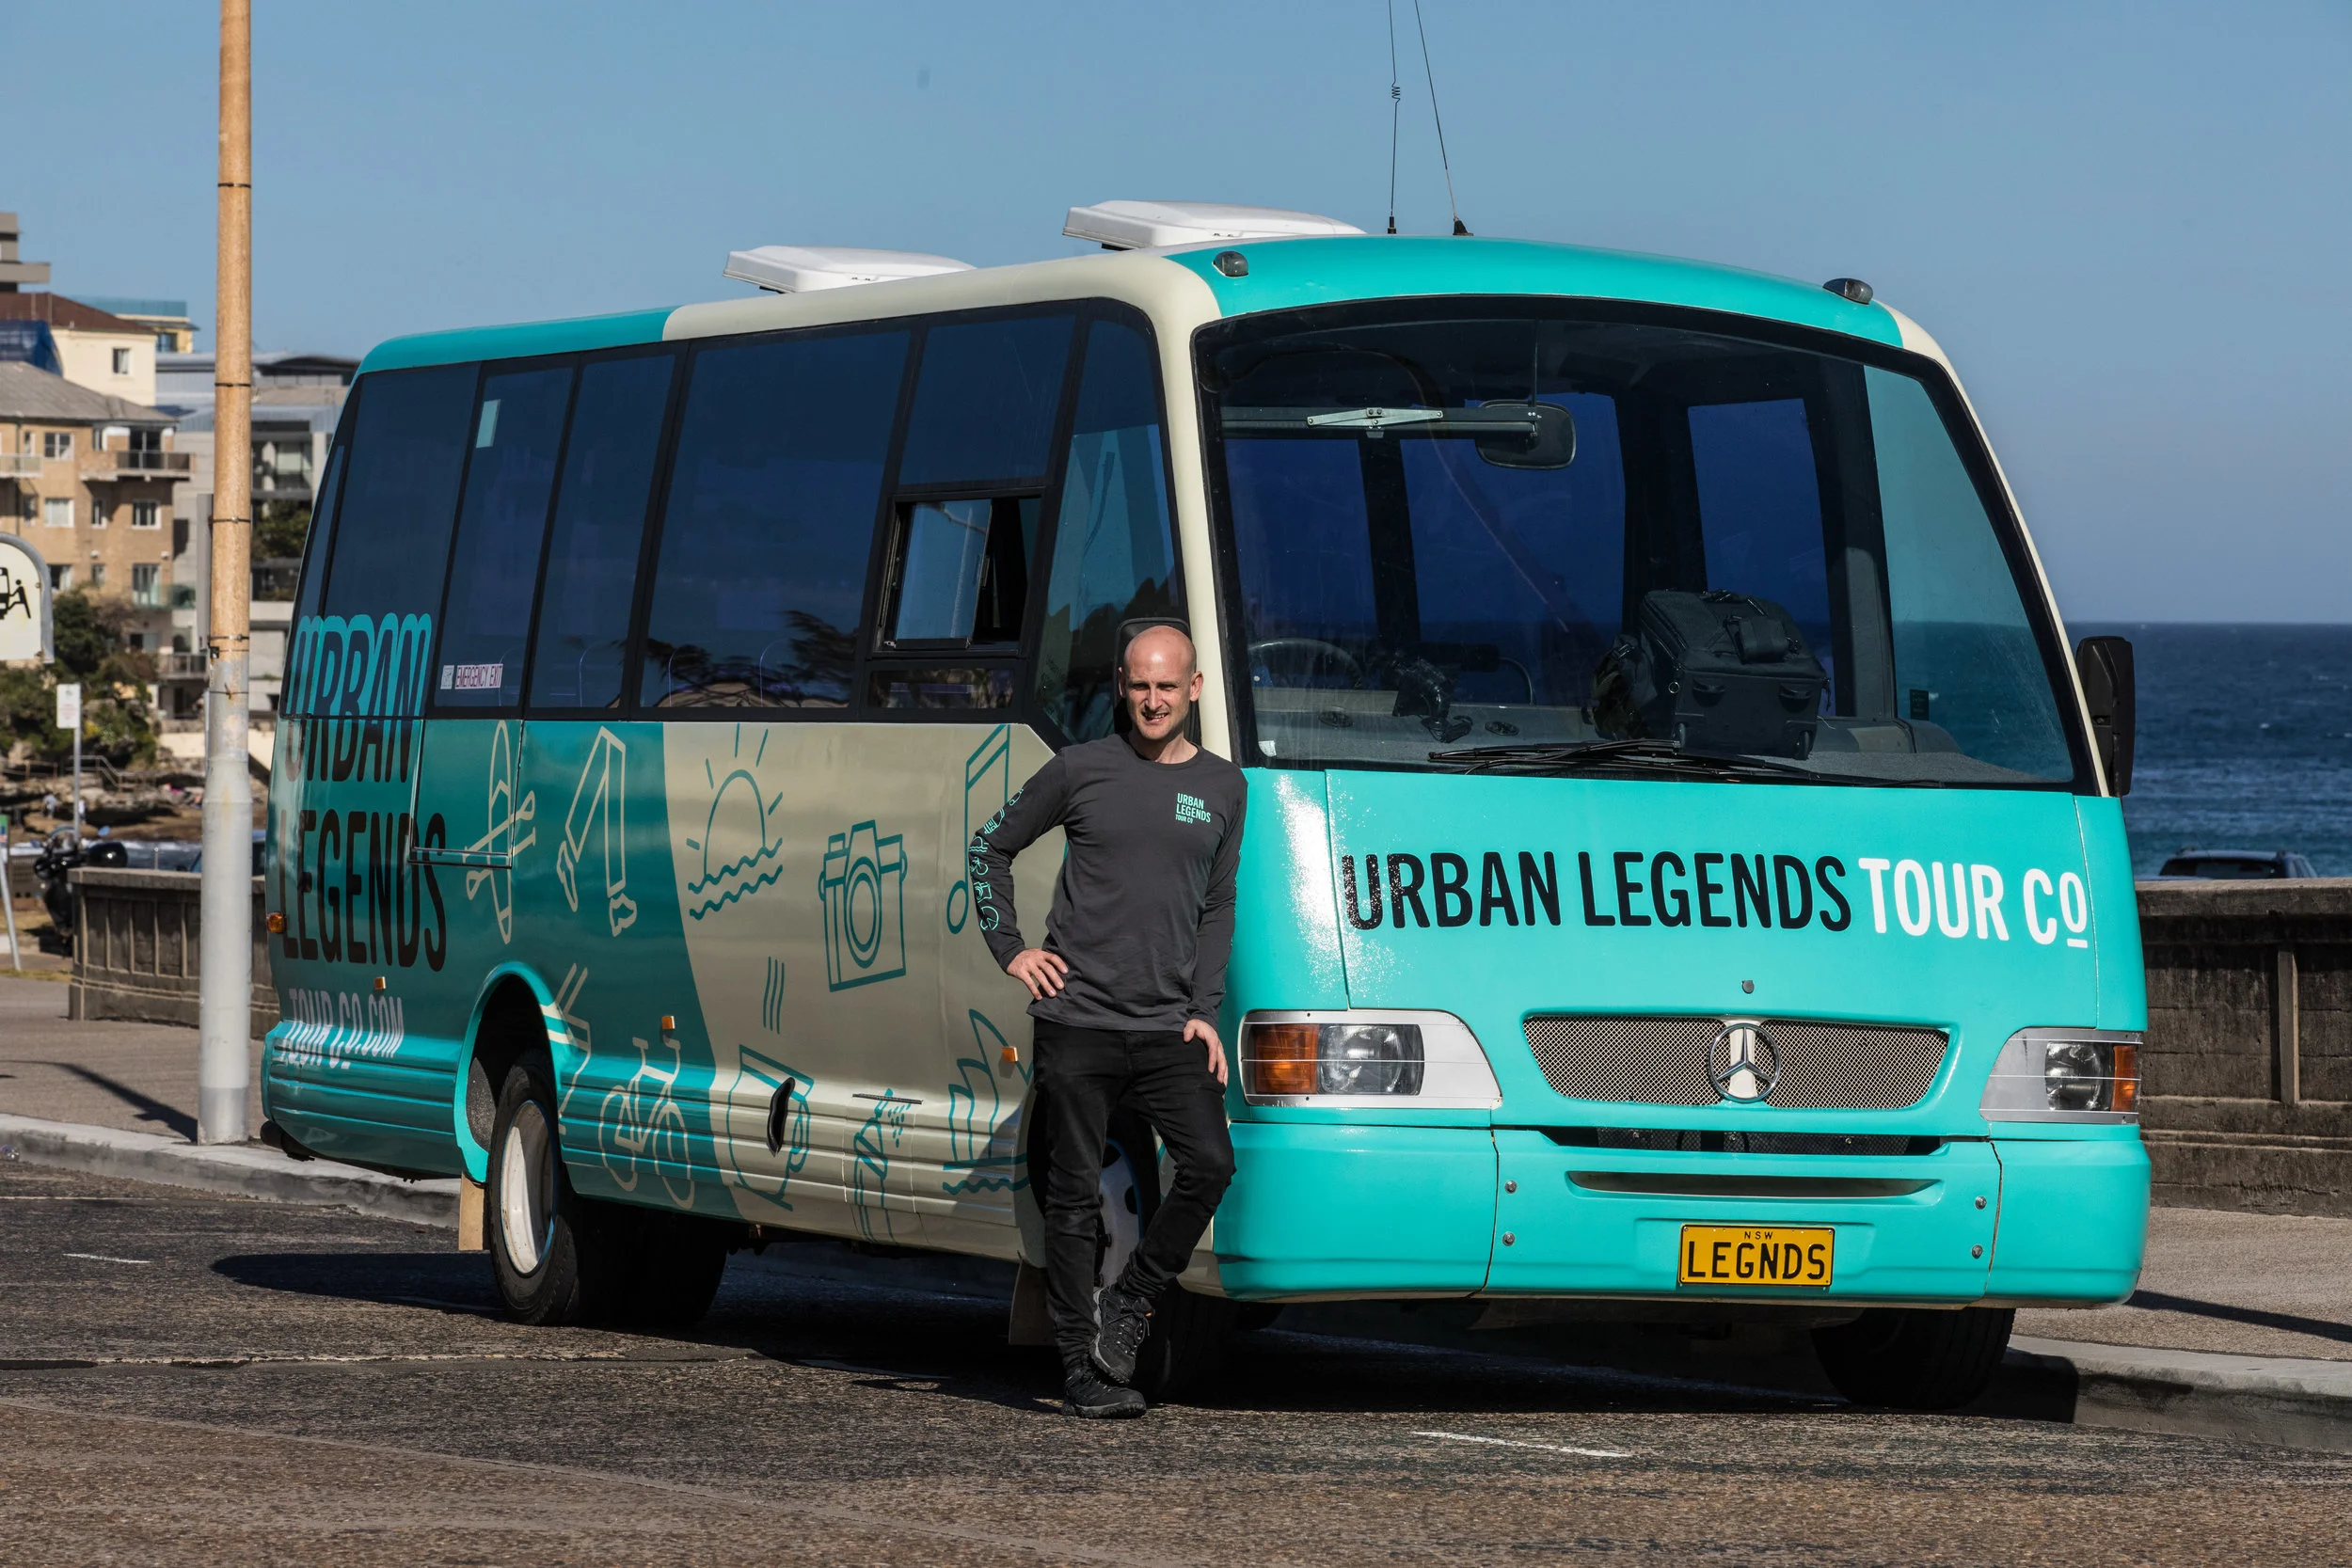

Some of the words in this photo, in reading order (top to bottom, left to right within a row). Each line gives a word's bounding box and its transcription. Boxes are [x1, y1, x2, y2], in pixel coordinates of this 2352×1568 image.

[456, 666, 489, 687] EMERGENCY
[489, 665, 502, 687] EXIT
[285, 621, 429, 783] URBAN
[1176, 803, 1212, 823] LEGENDS
[1177, 793, 1204, 810] URBAN
[1175, 814, 1186, 822] TOUR
[279, 808, 447, 972] LEGENDS
[1341, 851, 1561, 930] URBAN
[1579, 850, 1851, 932] LEGENDS
[1858, 858, 2009, 941] TOUR
[281, 989, 333, 1066] TOUR
[1744, 1231, 1773, 1240] NSW
[1688, 1241, 1826, 1279] LEGNDS
